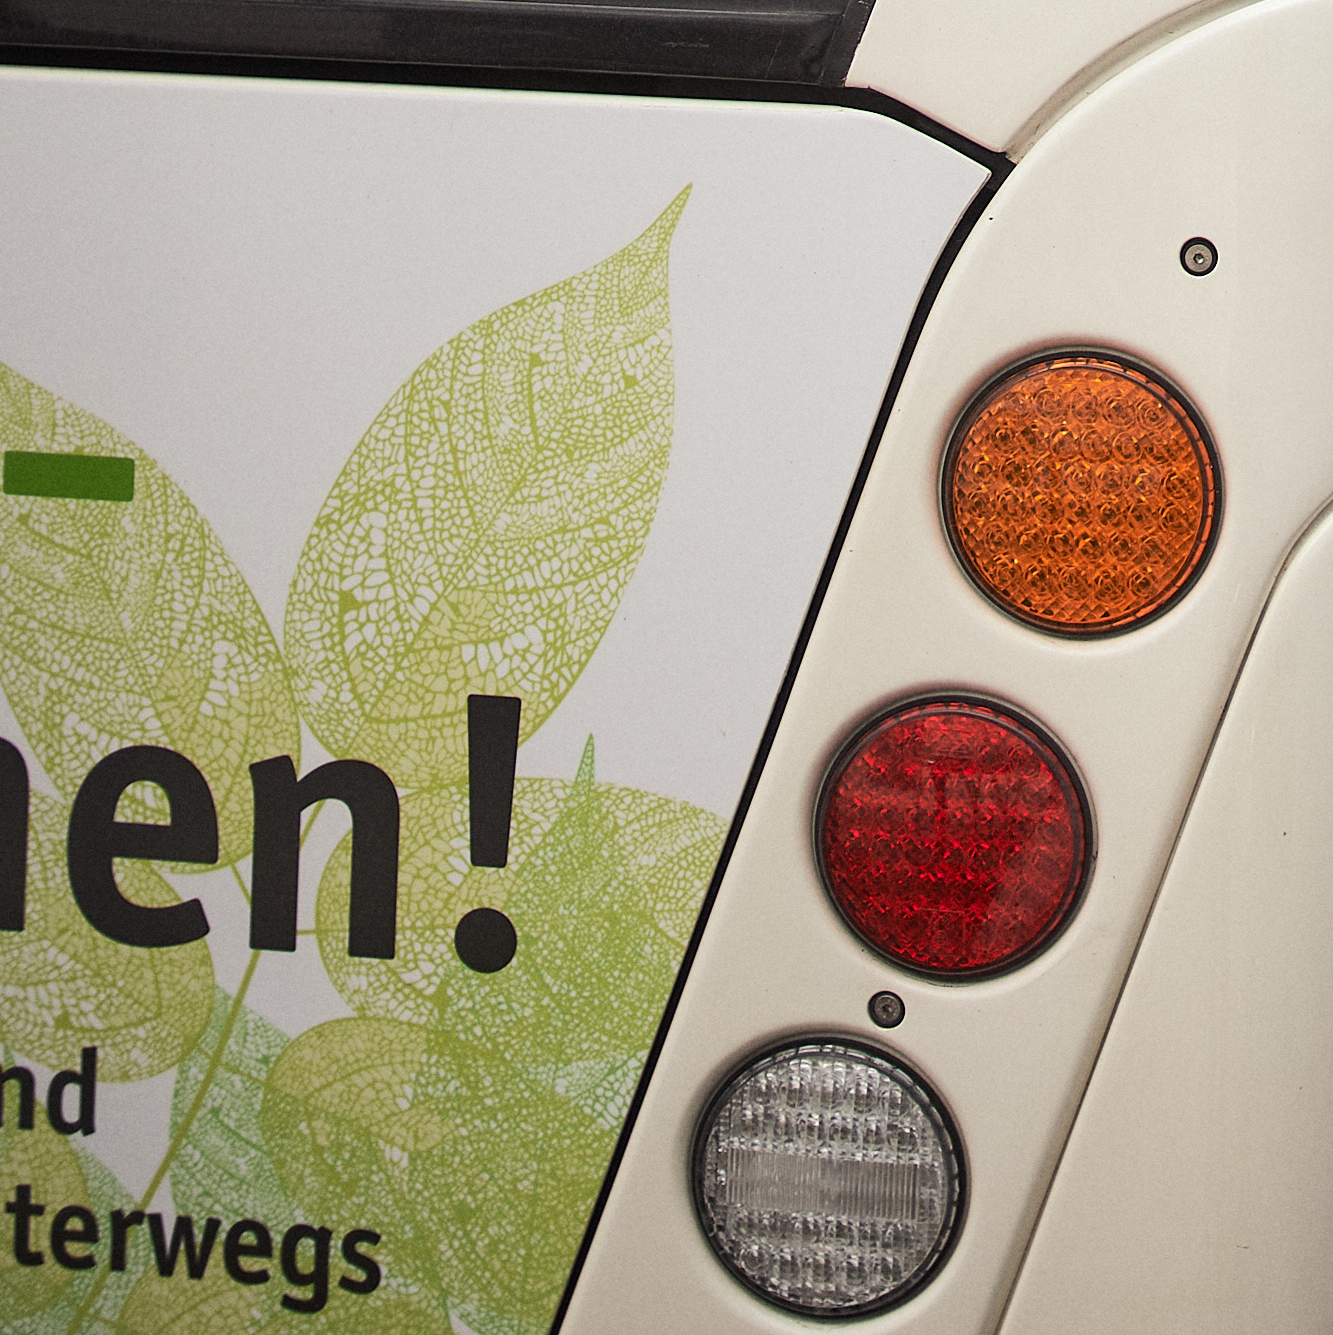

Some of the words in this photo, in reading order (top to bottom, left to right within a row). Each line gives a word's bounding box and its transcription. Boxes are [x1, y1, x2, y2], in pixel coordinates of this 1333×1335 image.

[0, 694, 523, 975] en!
[0, 1045, 98, 1137] nd
[4, 1183, 383, 1315] terwegs
